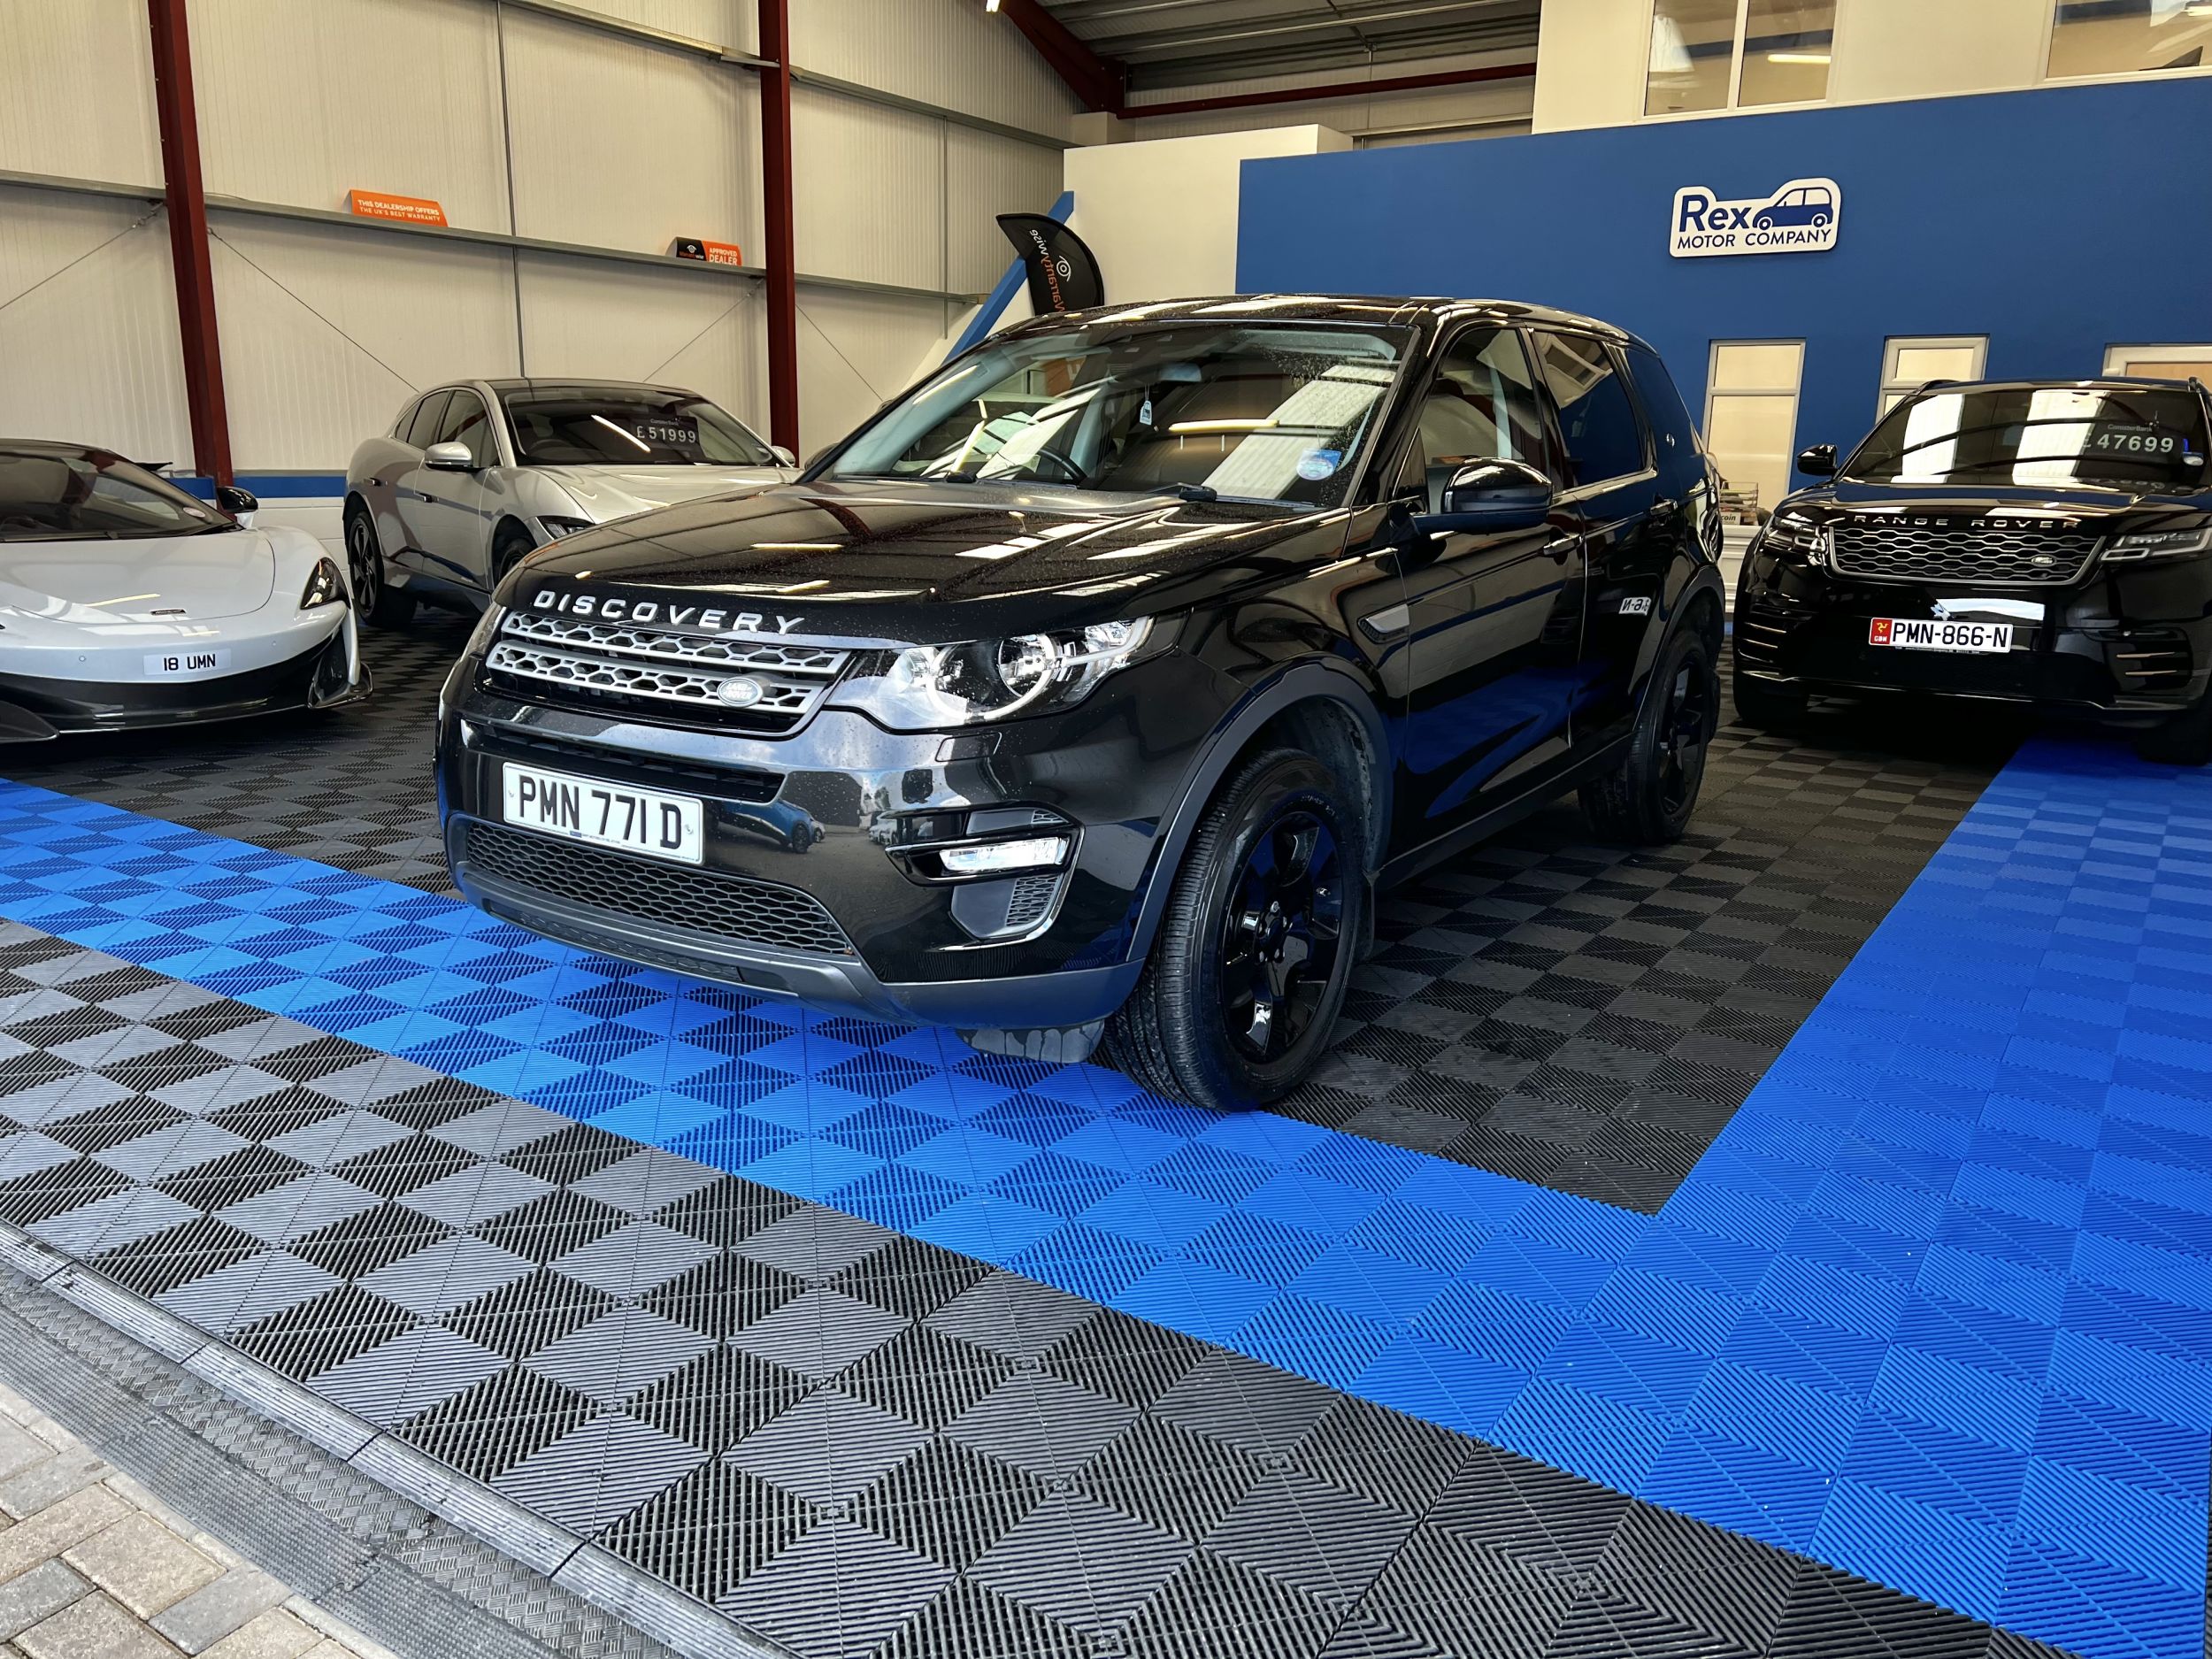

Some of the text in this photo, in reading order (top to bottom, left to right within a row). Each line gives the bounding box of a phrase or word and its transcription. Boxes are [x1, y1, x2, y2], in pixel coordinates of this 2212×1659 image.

[374, 202, 414, 211] DEALERSHIP
[415, 207, 440, 216] OFFERS
[407, 211, 441, 221] WARRANTY
[1678, 194, 1752, 233] Rex
[1678, 229, 1832, 250] MOTOR COMPANY
[709, 248, 737, 257] APPROVED
[709, 255, 738, 265] DEALER
[637, 426, 695, 443] £51999
[1854, 515, 2079, 529] RANGE ROVER
[534, 590, 804, 636] DISCOVERY
[1893, 623, 2008, 648] PMN-866-N
[164, 654, 216, 671] 18 UMN
[518, 774, 682, 849] PMN 771 D
